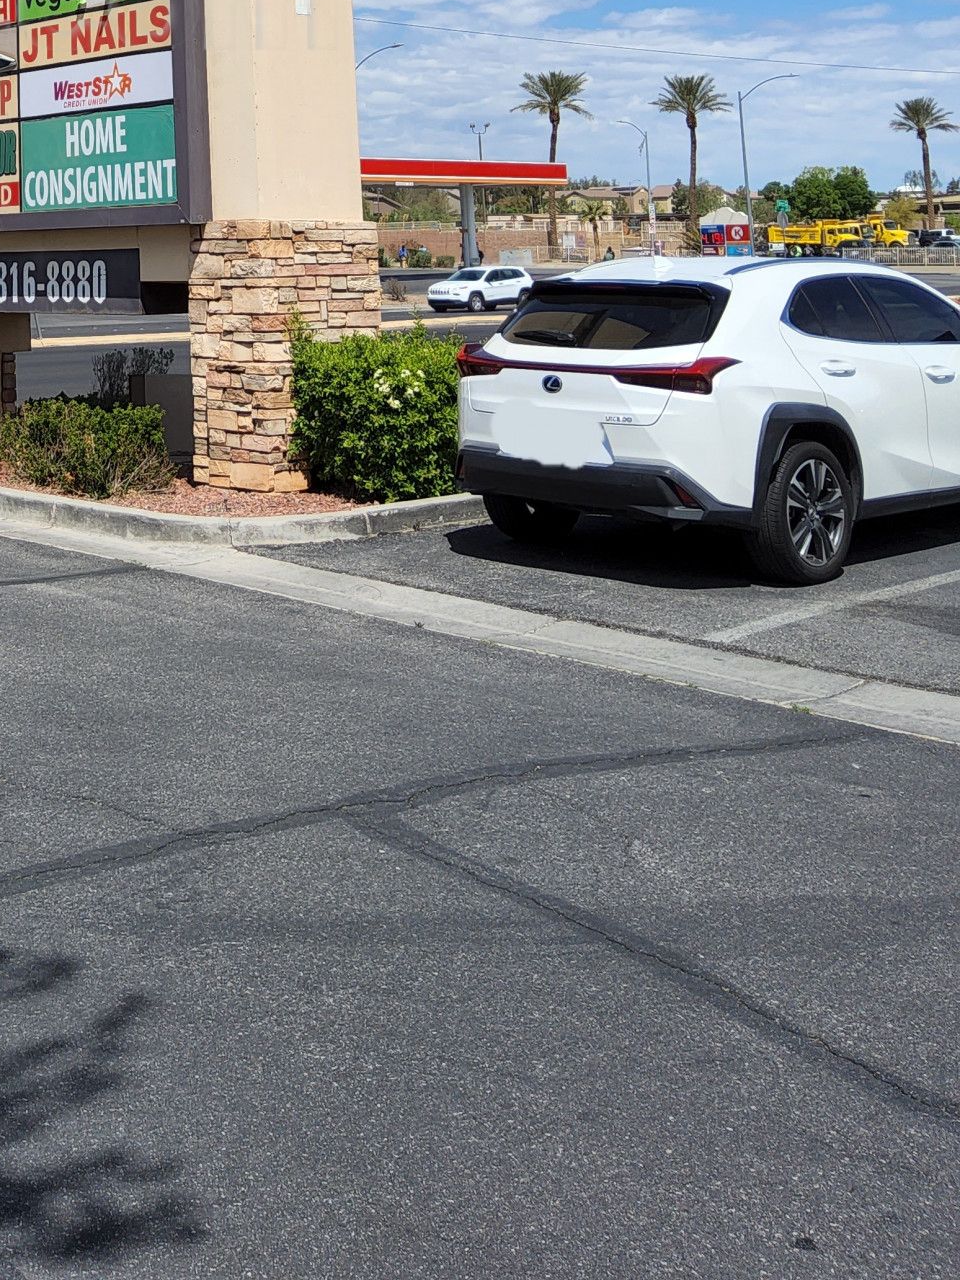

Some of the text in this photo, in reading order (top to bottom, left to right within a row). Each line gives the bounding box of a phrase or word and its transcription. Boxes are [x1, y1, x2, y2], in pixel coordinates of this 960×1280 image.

[23, 5, 170, 62] JT NAILS
[63, 96, 108, 109] CREDIT UNION
[66, 115, 127, 158] HOME
[24, 159, 176, 207] CONSIGNMENT
